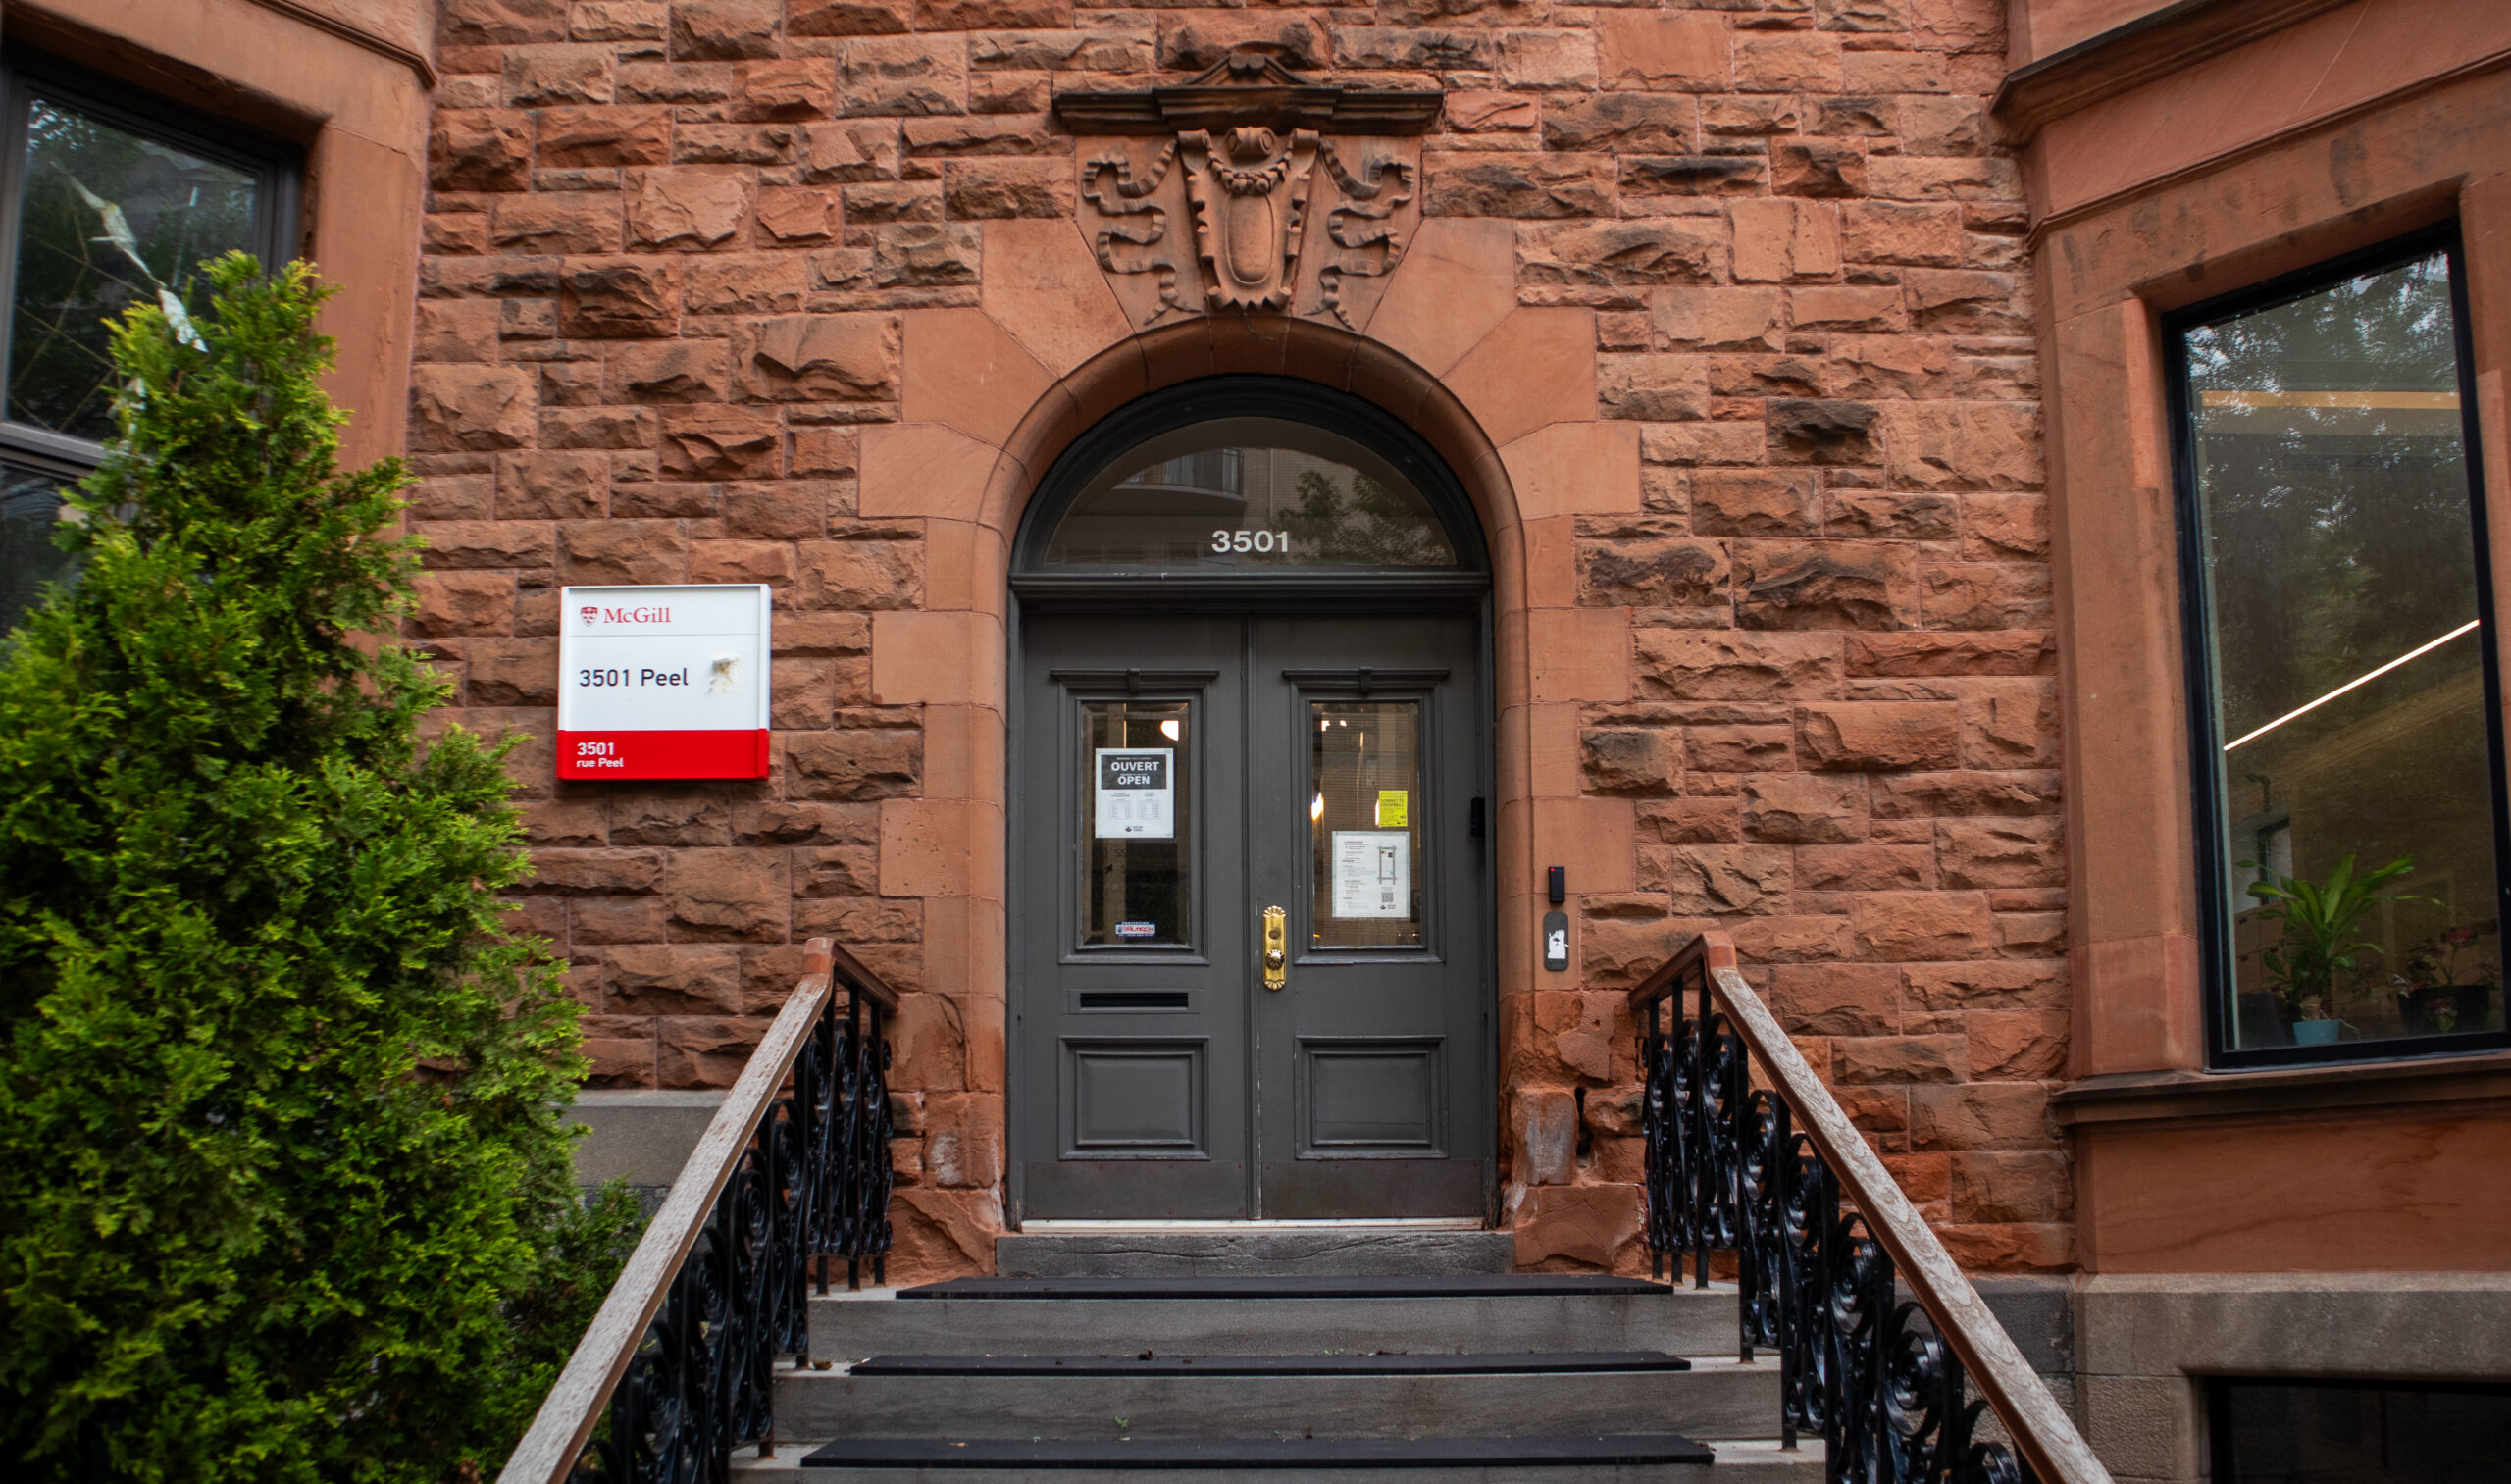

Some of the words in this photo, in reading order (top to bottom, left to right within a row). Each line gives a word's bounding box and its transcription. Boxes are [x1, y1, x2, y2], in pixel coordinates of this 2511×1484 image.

[1211, 530, 1288, 553] 3501
[603, 606, 672, 624] McGill
[579, 669, 630, 687] 3501
[641, 668, 689, 686] Peel
[577, 742, 615, 756] 3501
[598, 757, 625, 768] Peel
[1110, 761, 1159, 772] OUVERT
[1117, 775, 1151, 785] OPEN
